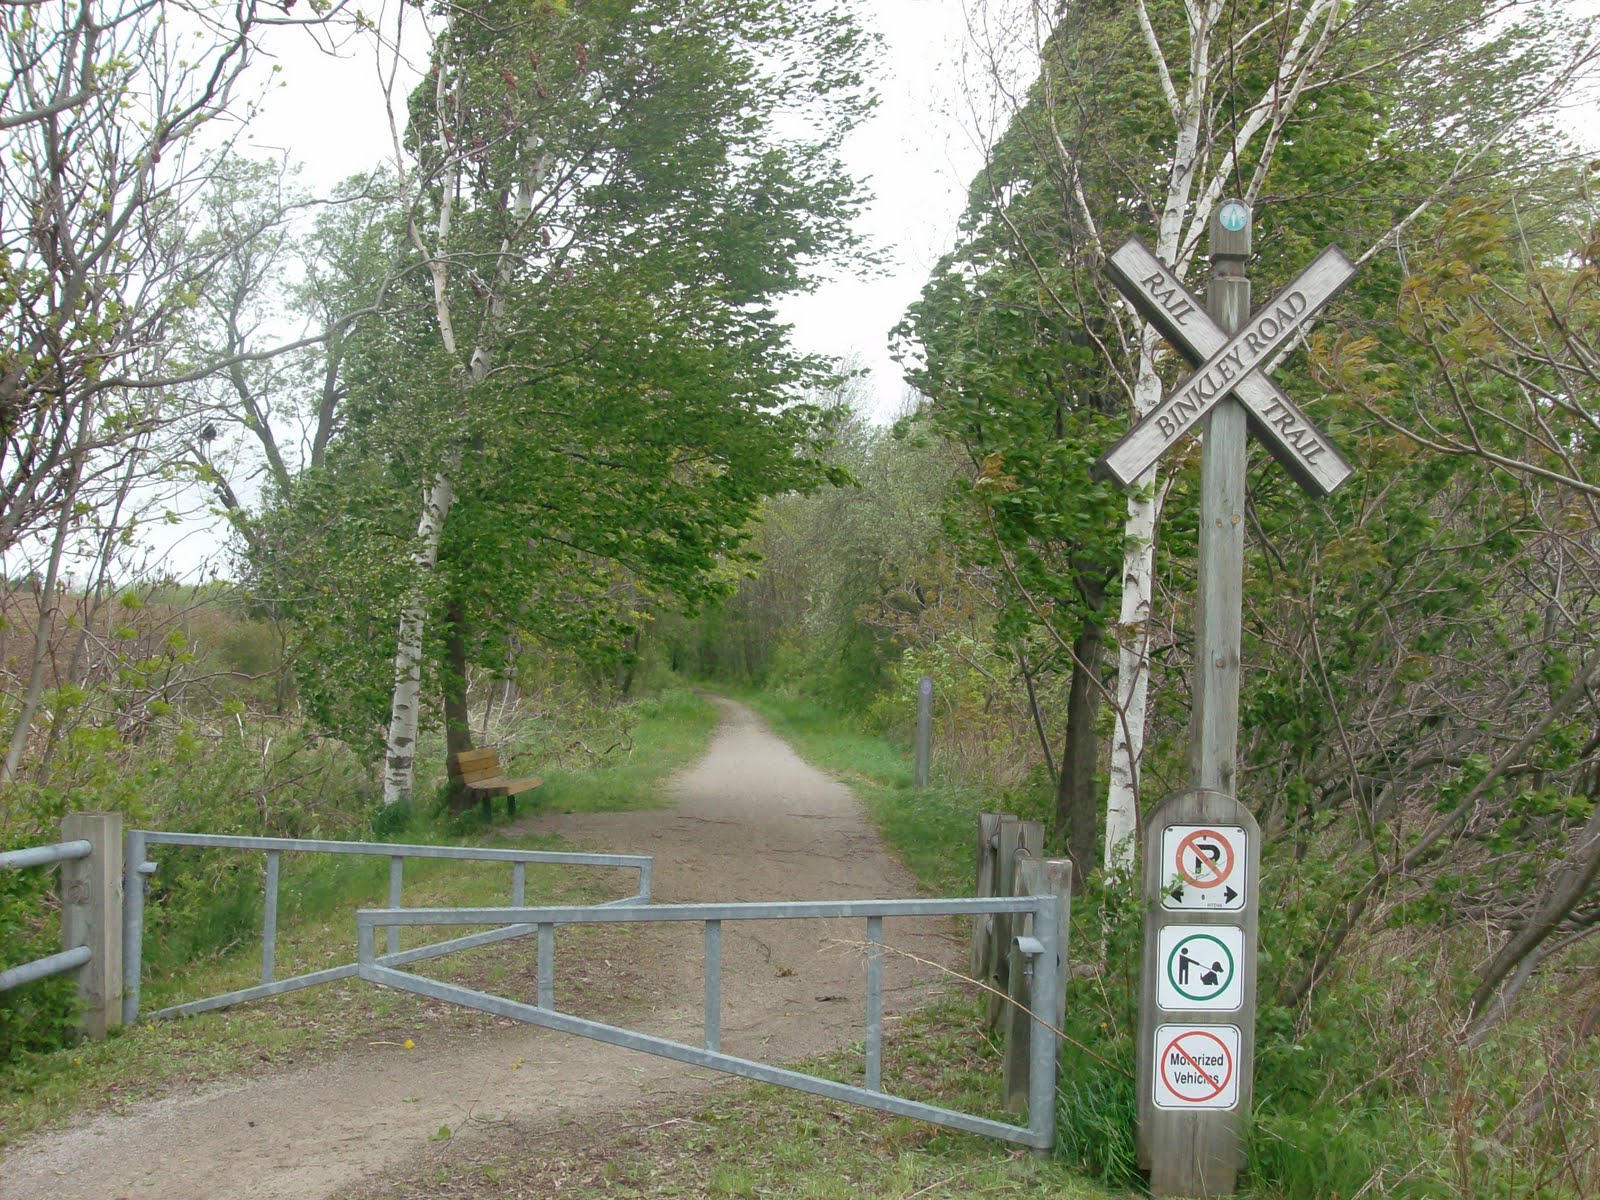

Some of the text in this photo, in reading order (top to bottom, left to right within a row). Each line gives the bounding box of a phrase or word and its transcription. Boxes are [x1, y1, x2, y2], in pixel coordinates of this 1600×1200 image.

[1141, 271, 1197, 326] RAIL
[1153, 290, 1308, 441] BINKLEY ROAD
[1261, 396, 1327, 467] TRAIL
